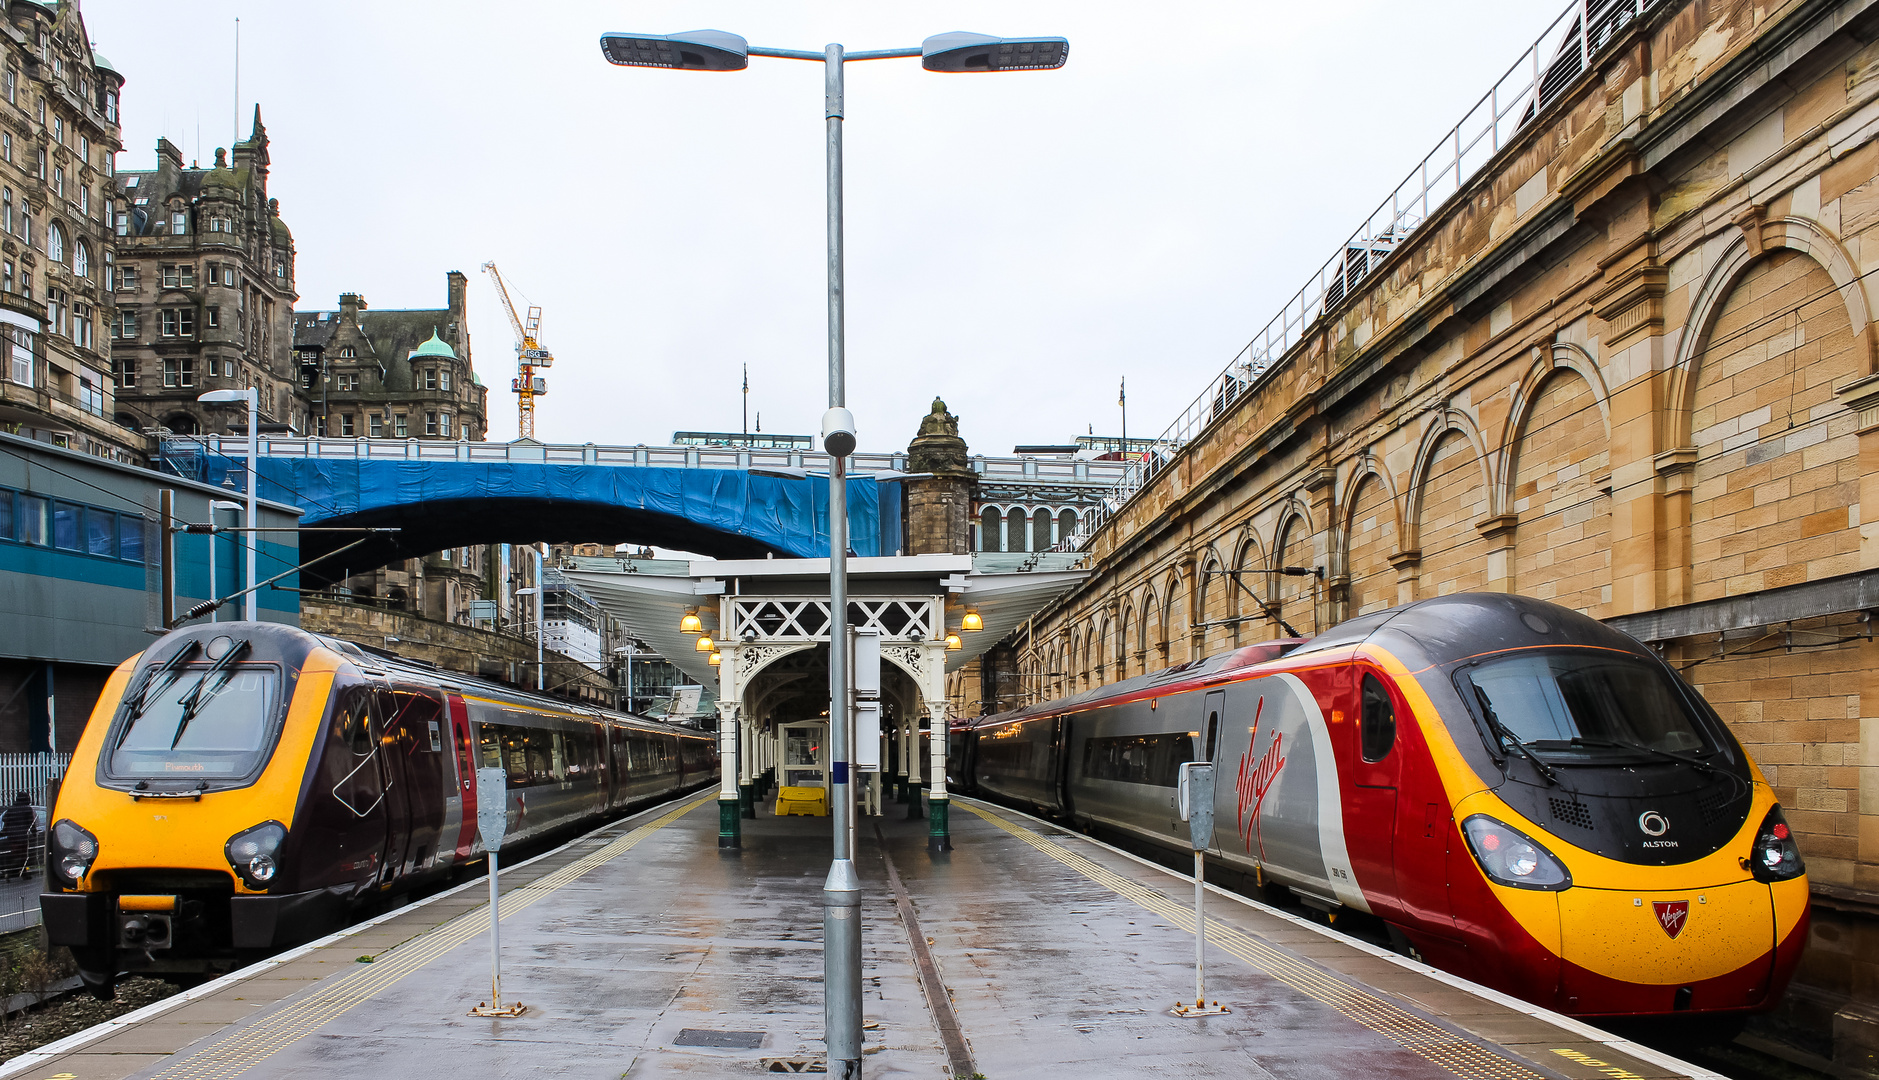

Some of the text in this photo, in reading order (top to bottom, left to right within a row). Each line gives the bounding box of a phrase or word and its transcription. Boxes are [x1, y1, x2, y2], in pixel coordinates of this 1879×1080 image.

[67, 204, 85, 225] Hilton
[527, 350, 540, 358] ISG
[165, 762, 205, 772] Plymouth
[1235, 694, 1286, 864] Virgin
[1661, 904, 1686, 929] Virgin
[1548, 1048, 1646, 1080] MIND TH
